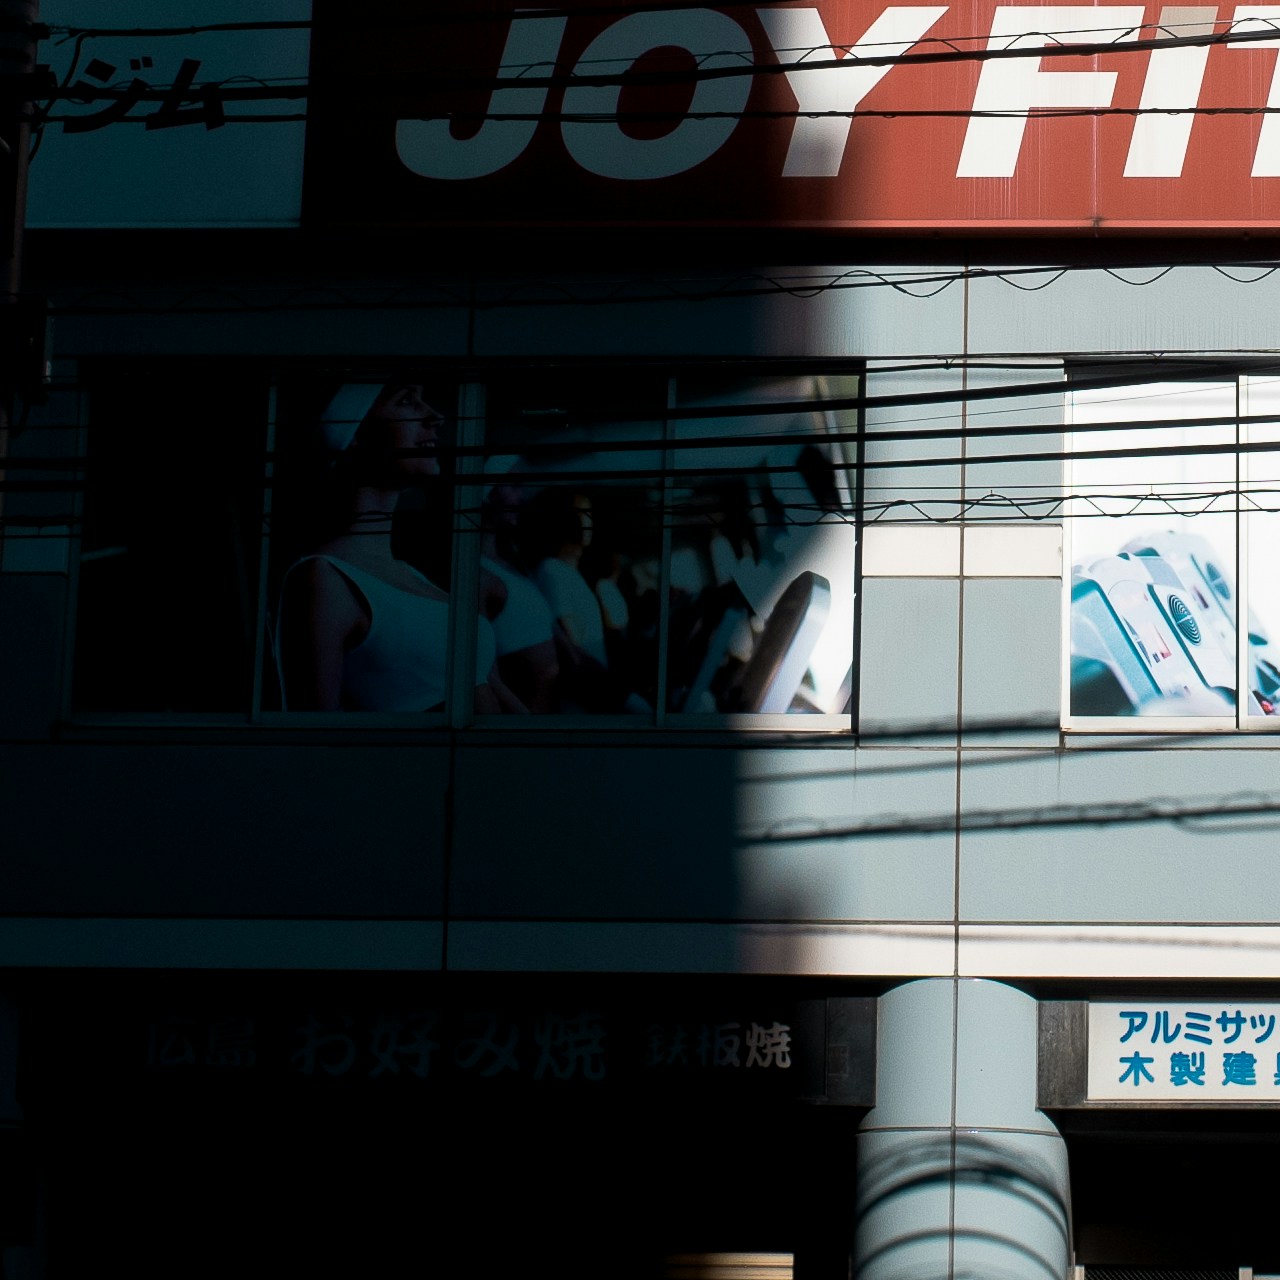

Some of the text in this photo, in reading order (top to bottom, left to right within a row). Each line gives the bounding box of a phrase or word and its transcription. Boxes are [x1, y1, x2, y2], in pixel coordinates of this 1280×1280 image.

[289, 1007, 607, 1082] お好み焼
[645, 1022, 792, 1069] 鉄板焼
